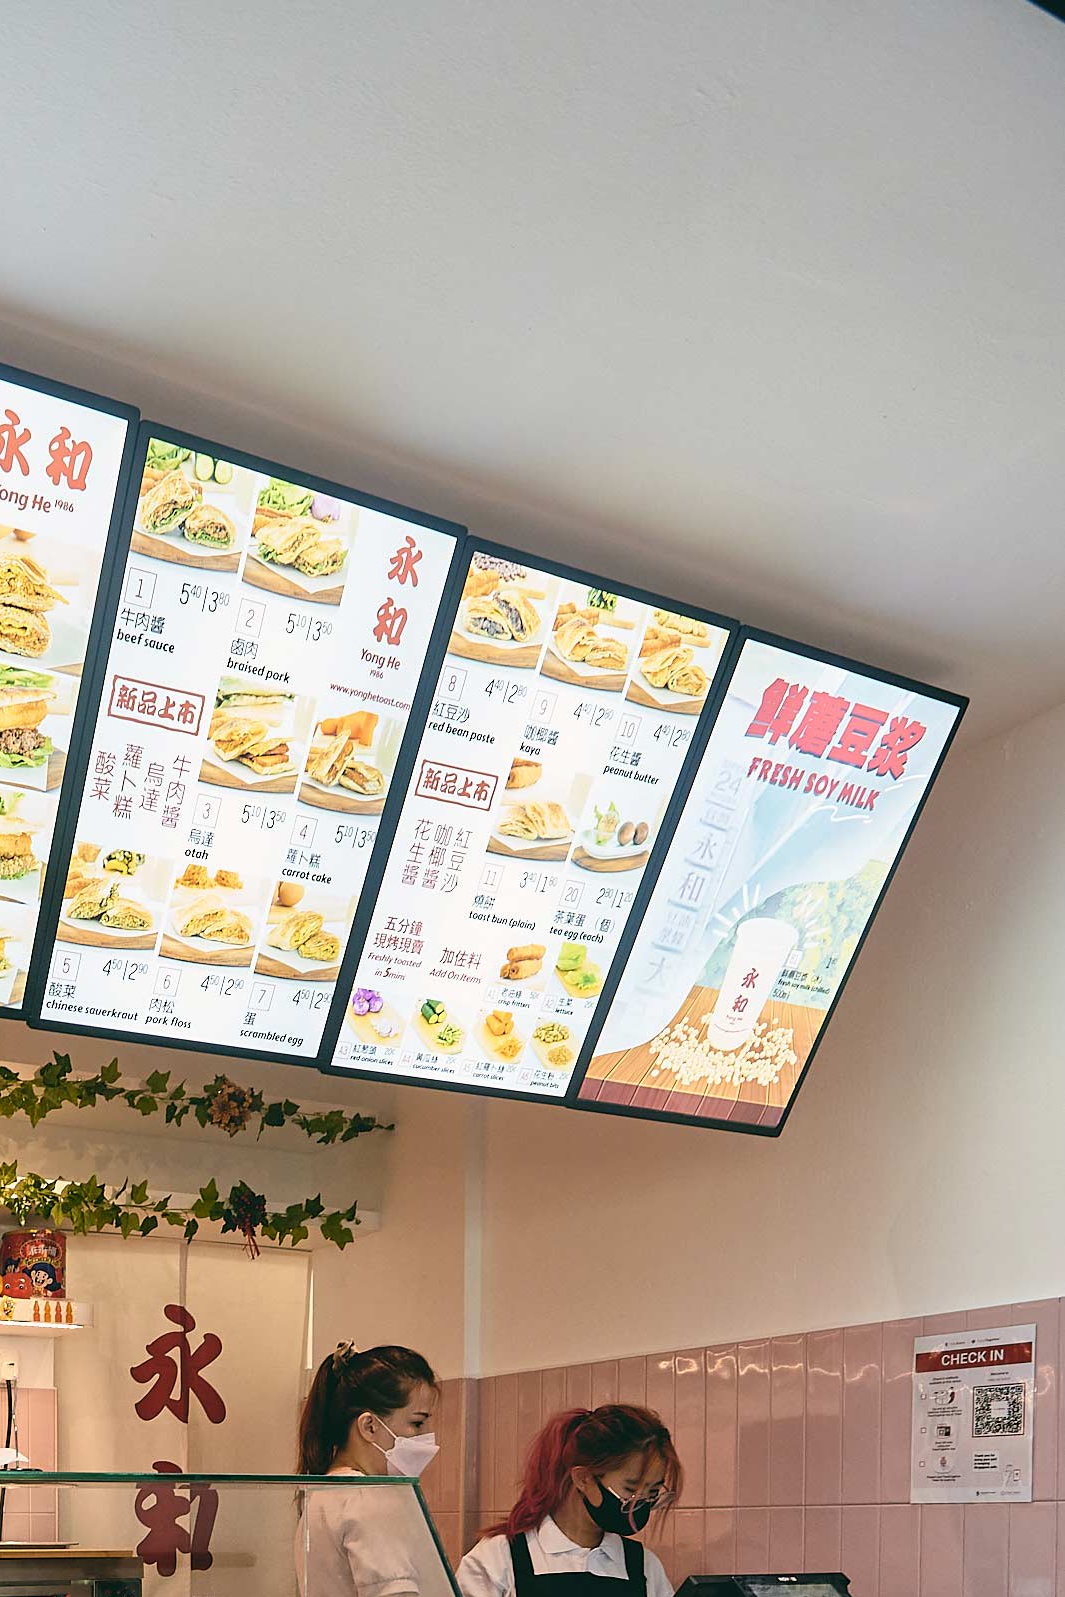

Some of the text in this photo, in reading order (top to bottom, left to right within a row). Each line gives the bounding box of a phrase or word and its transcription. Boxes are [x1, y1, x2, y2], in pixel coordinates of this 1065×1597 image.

[32, 494, 51, 513] He
[54, 499, 74, 513] 1986
[373, 536, 423, 646] 永和
[120, 608, 165, 634] 牛肉醬
[117, 628, 175, 654] beef sauce
[361, 648, 401, 670] Yong He
[227, 658, 290, 684] braised pork
[369, 670, 384, 680] 1986
[118, 684, 197, 725] 新品上市
[330, 682, 411, 711] www.yonghetoast.com
[429, 720, 495, 745] red bean paste
[520, 743, 540, 758] kaya
[603, 763, 660, 785] peanut butter
[747, 757, 880, 811] FRESH SOY MILK
[423, 768, 491, 801] 新品上市
[185, 848, 209, 860] otah
[282, 867, 332, 885] carrot cake
[469, 911, 535, 930] toast bun (plain)
[550, 926, 604, 944] tea egg (each)
[368, 952, 422, 969] Freshly toasted
[375, 968, 382, 977] in
[430, 968, 482, 984] Add On Items
[733, 968, 759, 1012] 永和
[46, 999, 138, 1021] chinese sauerkraut
[145, 1015, 191, 1029] pork floss
[240, 1028, 303, 1047] scrambled egg
[941, 1349, 1004, 1366] CHECK IN
